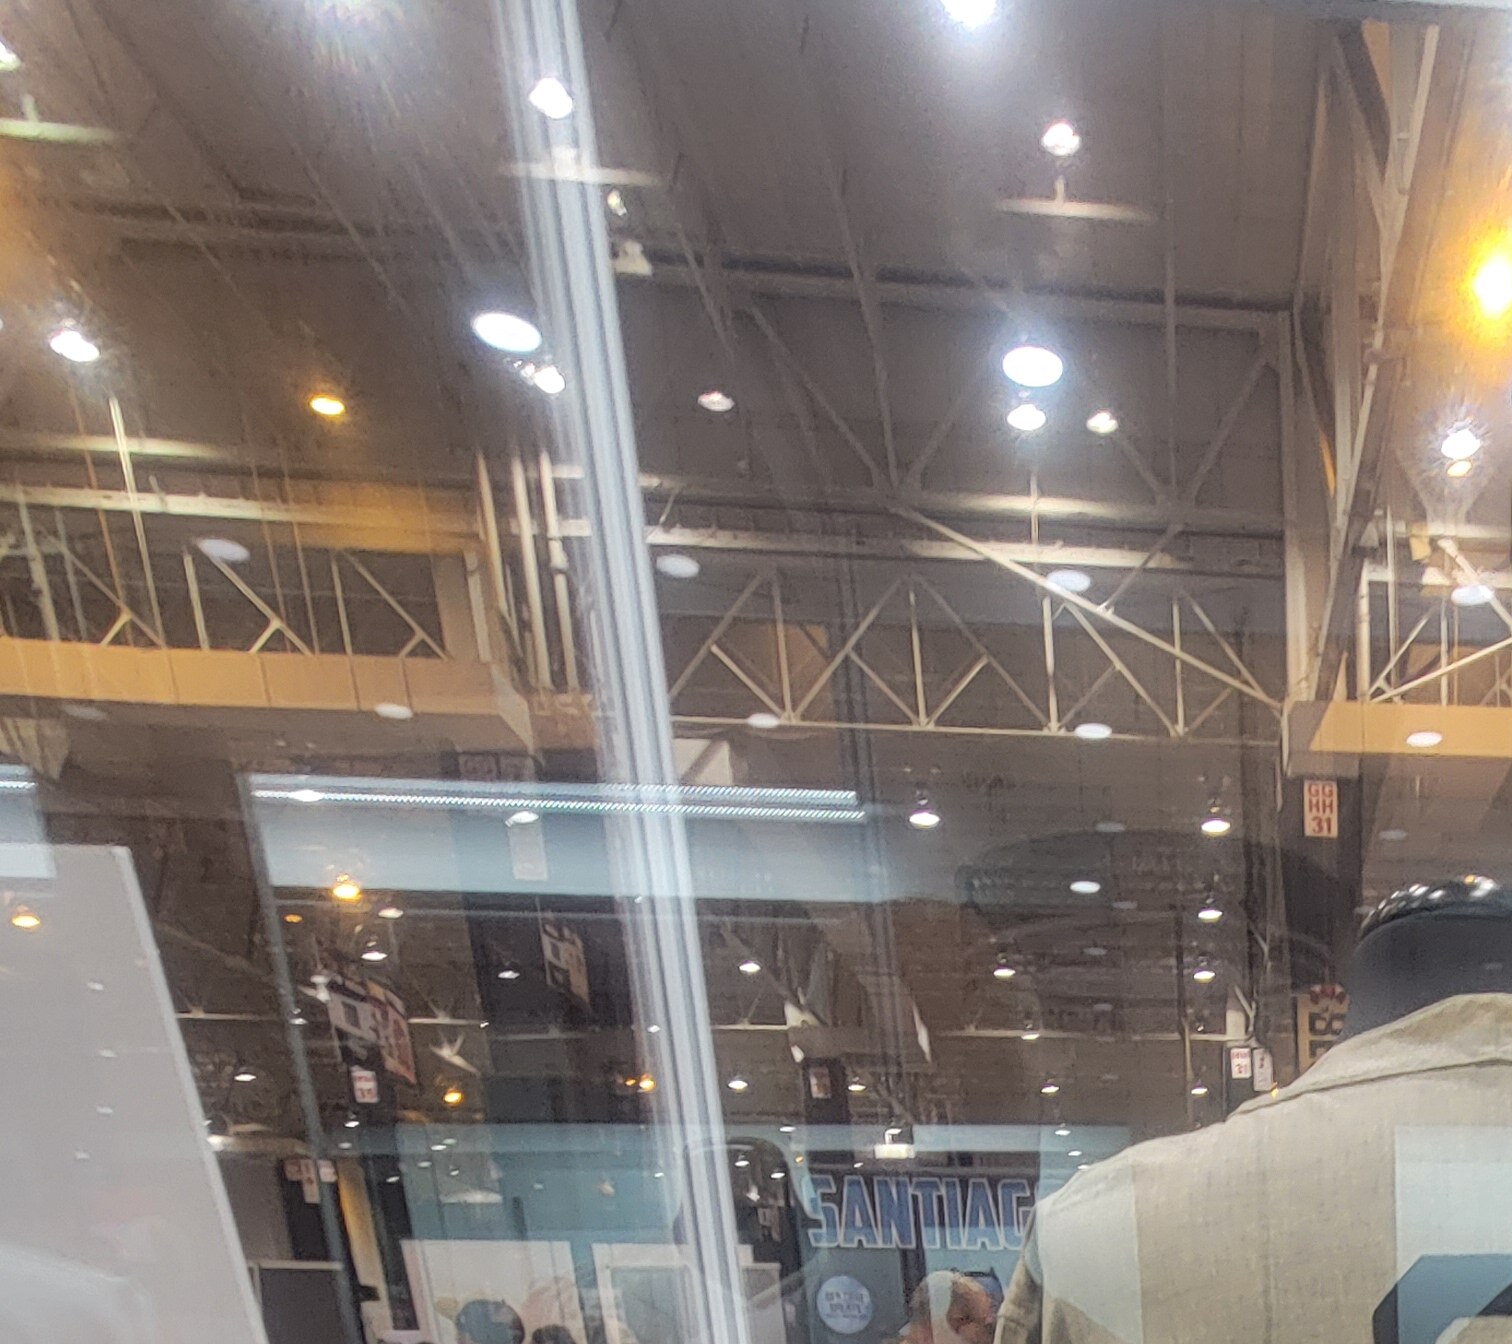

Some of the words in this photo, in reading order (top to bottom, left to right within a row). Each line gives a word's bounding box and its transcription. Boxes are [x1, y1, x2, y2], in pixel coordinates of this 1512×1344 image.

[1308, 783, 1334, 798] GG
[1308, 798, 1334, 815] HH
[1311, 816, 1333, 834] 31
[803, 1175, 1038, 1250] SANTIAG
